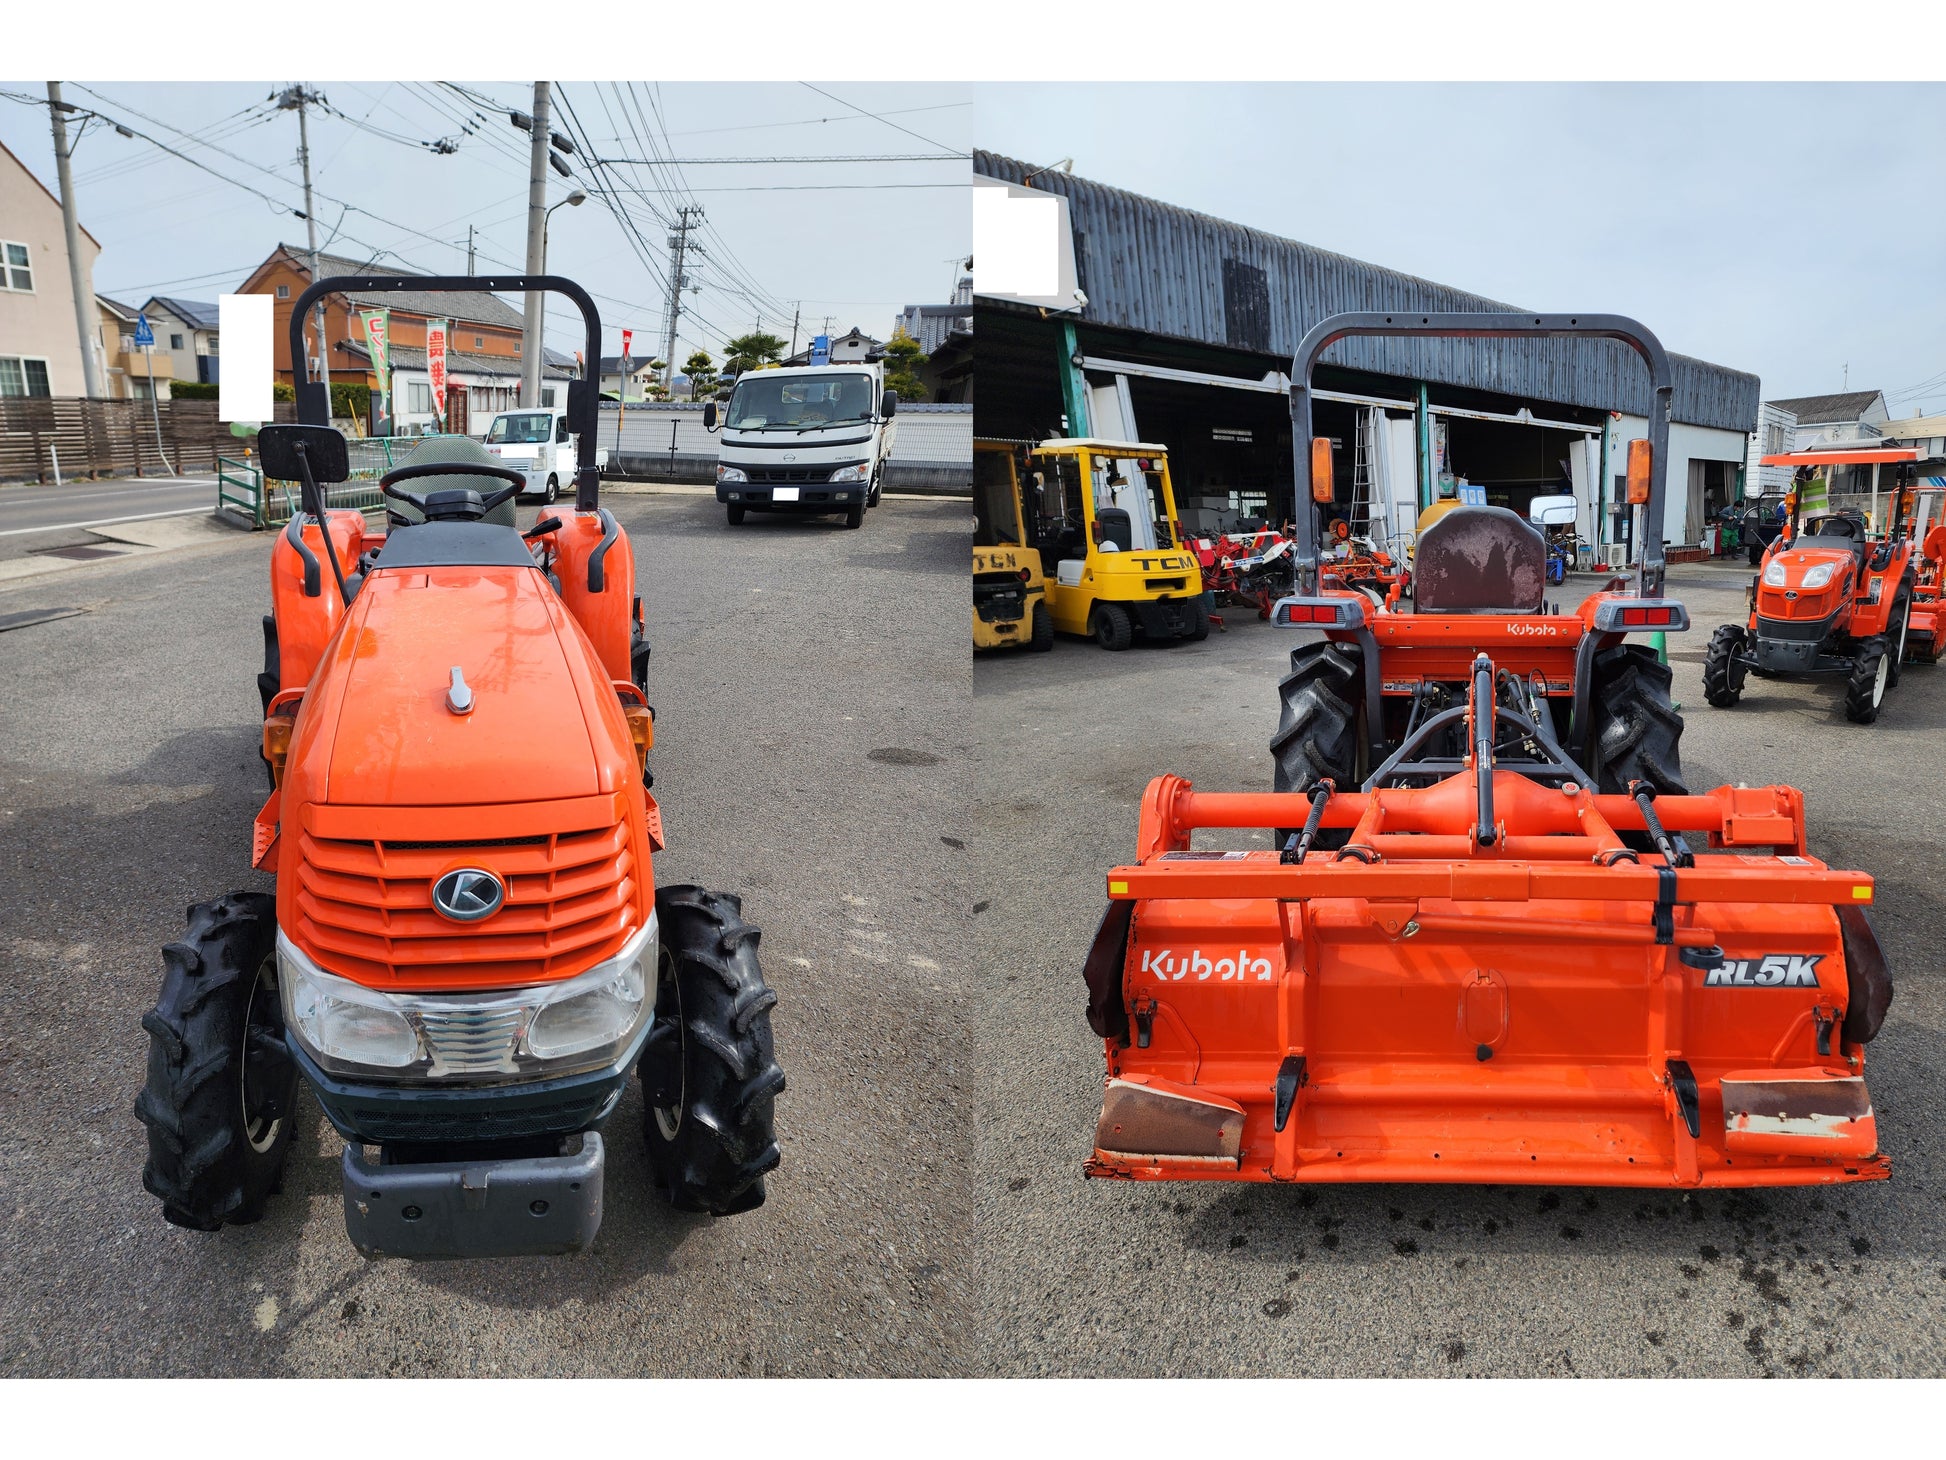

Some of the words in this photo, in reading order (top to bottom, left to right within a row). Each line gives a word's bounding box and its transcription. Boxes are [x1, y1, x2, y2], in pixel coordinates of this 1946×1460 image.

[1131, 556, 1194, 571] TCM
[1507, 623, 1557, 636] Kubota
[1141, 950, 1272, 981] Kubota
[1706, 956, 1820, 986] RL5K
